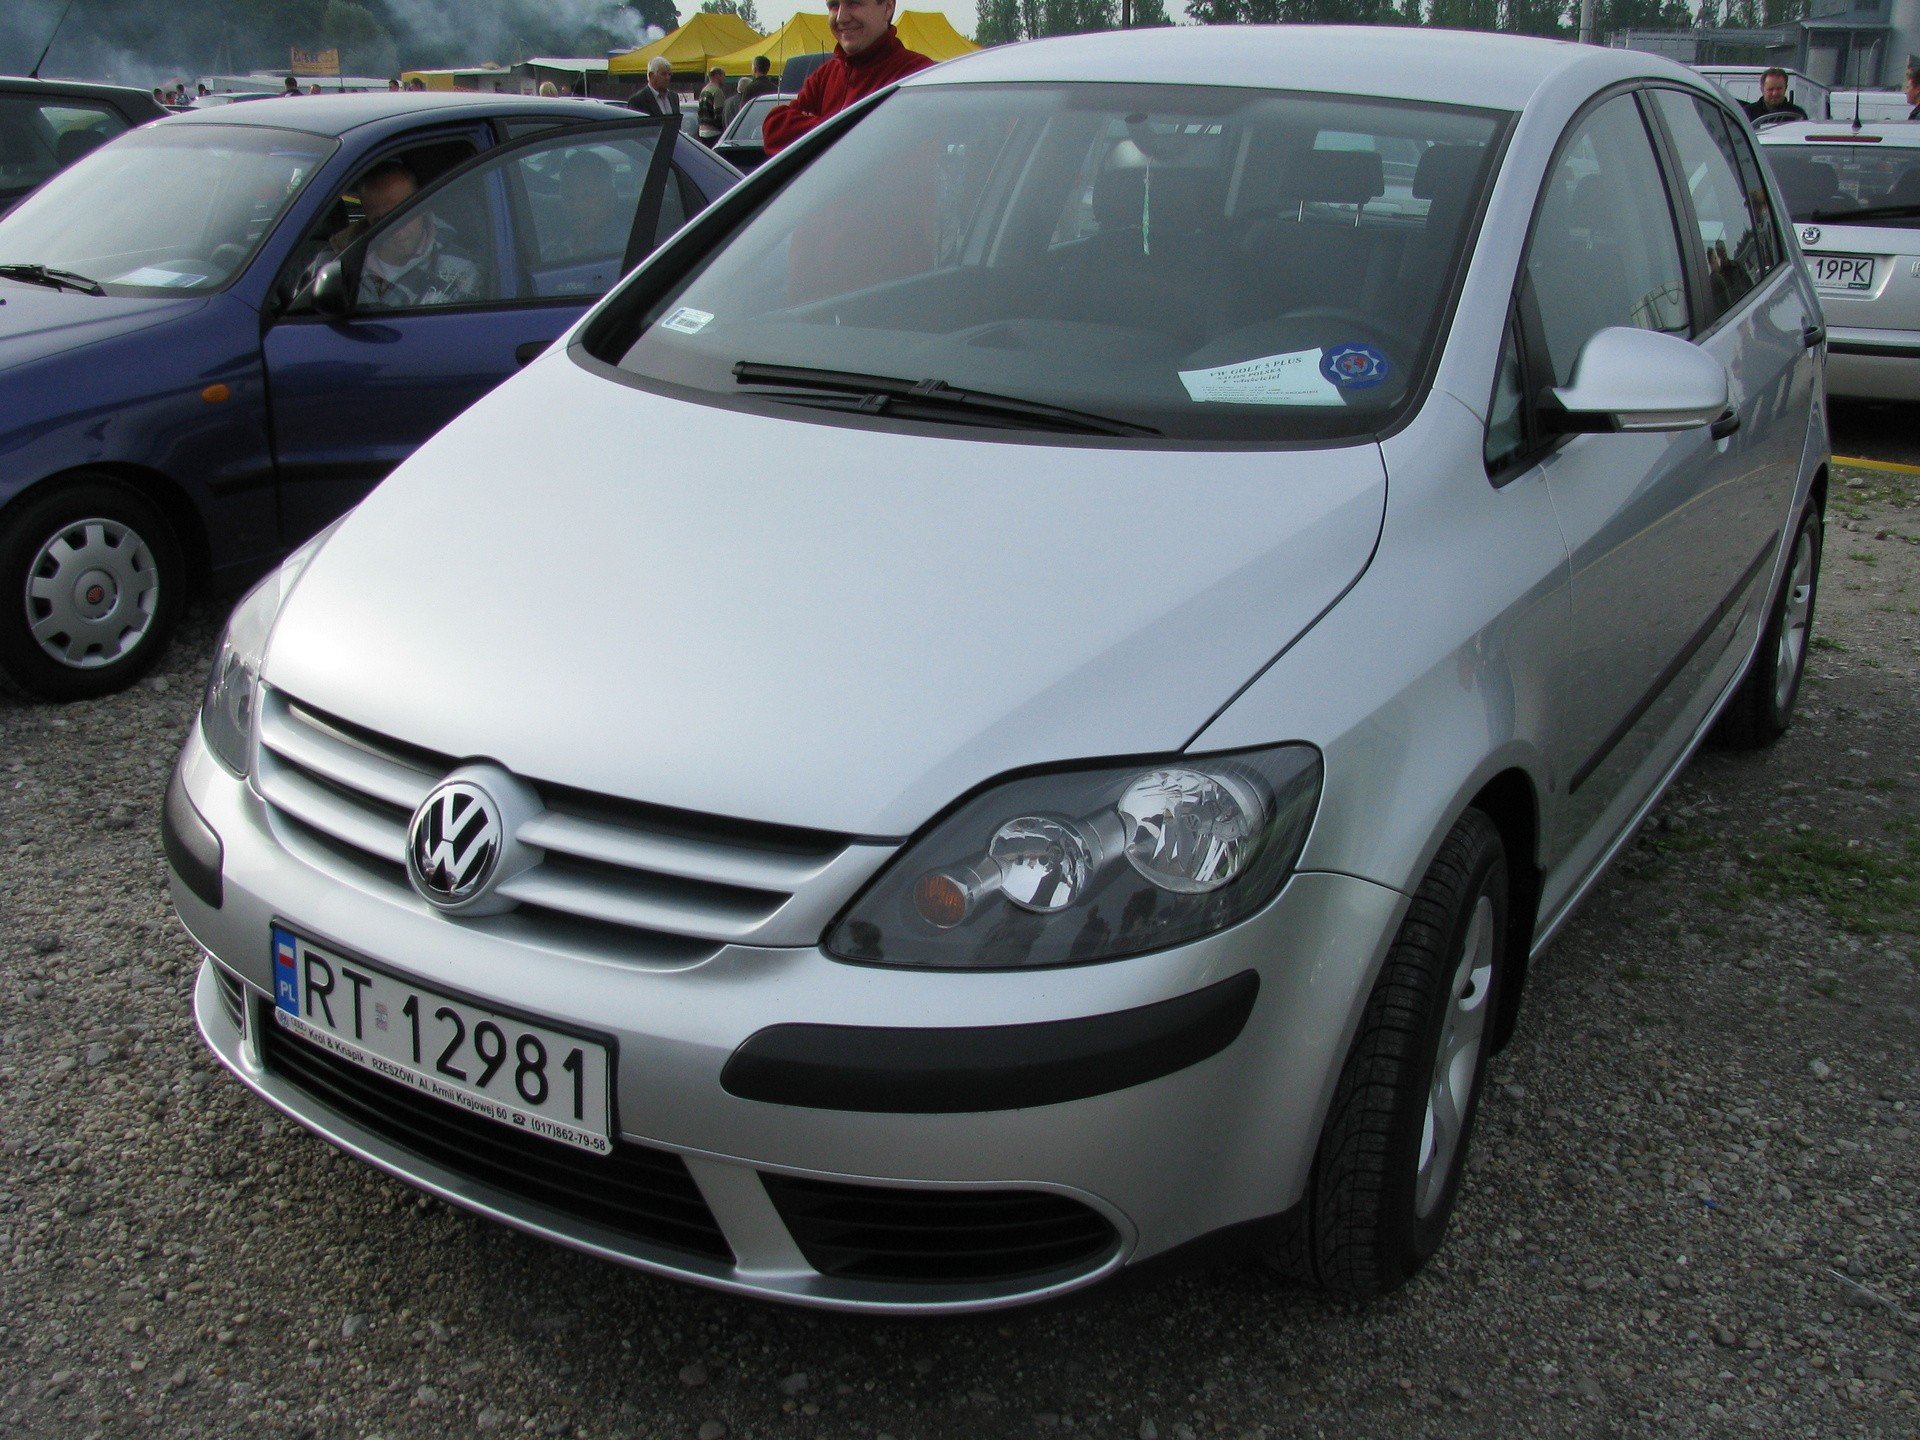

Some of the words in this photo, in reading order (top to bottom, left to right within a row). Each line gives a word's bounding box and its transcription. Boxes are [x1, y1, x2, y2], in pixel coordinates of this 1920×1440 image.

[1816, 258, 1868, 282] 19PK
[1230, 365, 1261, 374] GOLF
[1273, 357, 1302, 367] PLUS
[1248, 368, 1282, 377] POLSKA
[280, 980, 297, 1003] PL
[304, 949, 373, 1040] RT
[402, 994, 583, 1121] 12981
[309, 1028, 326, 1042] Król
[327, 1037, 334, 1048] &
[335, 1041, 365, 1064] Knapik
[372, 1058, 415, 1085] RZESZÓW
[432, 1083, 455, 1101] Armii
[456, 1091, 495, 1117] Krajowej
[496, 1106, 507, 1120] 60
[531, 1117, 606, 1151] (017)862-79-58
